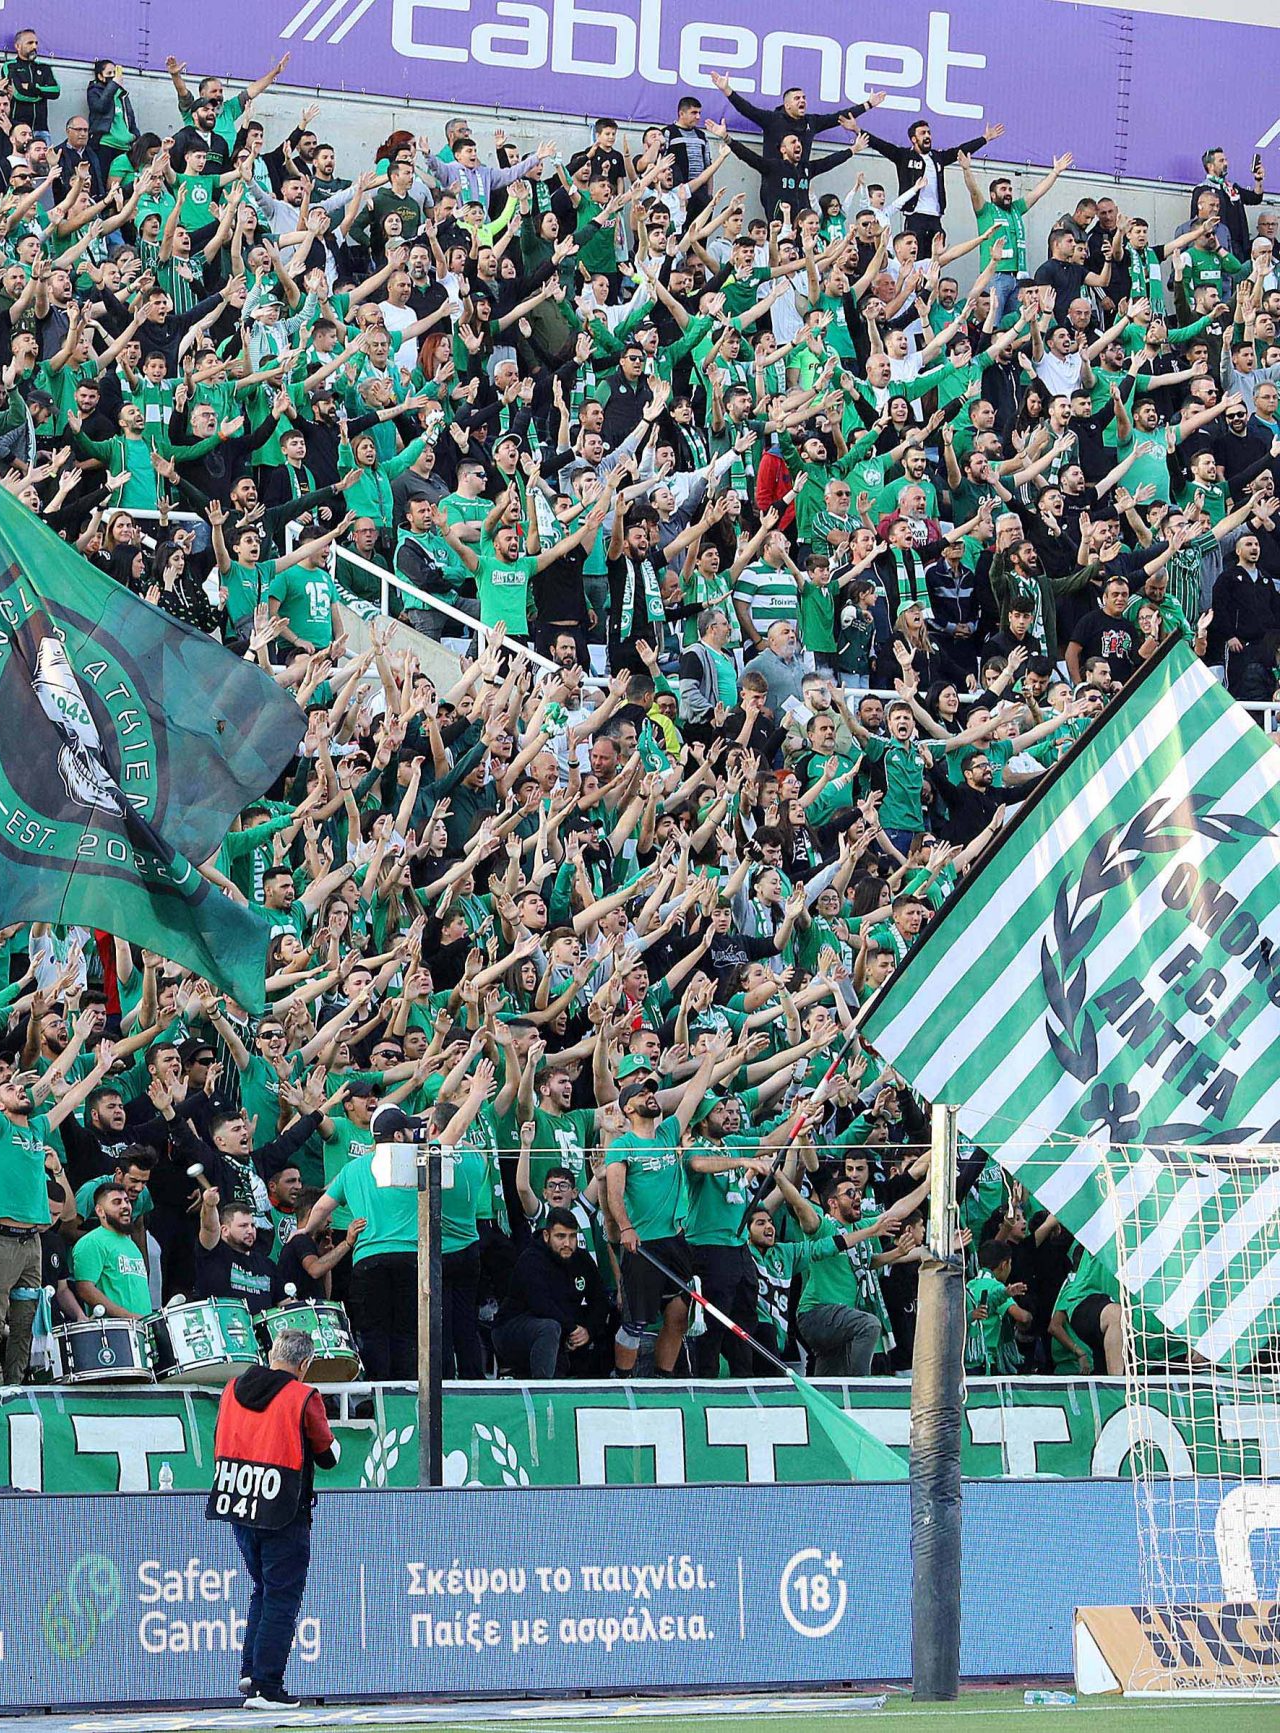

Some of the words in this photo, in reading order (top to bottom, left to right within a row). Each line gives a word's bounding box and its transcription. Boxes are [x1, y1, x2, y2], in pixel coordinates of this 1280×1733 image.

[391, 0, 988, 120] cablenet
[305, 582, 330, 617] 15
[5, 809, 56, 850] EST.
[1093, 976, 1239, 1121] ANTIFA
[215, 1493, 258, 1520] 041
[137, 1557, 238, 1603] Safer
[406, 1558, 527, 1604] Σκέψου
[535, 1565, 571, 1593] το
[581, 1555, 716, 1600] παιχνίδι.
[138, 1607, 322, 1662] Gambg
[410, 1610, 501, 1652] Παίξε
[511, 1615, 550, 1652] με
[558, 1607, 715, 1651] ασφάλεια.
